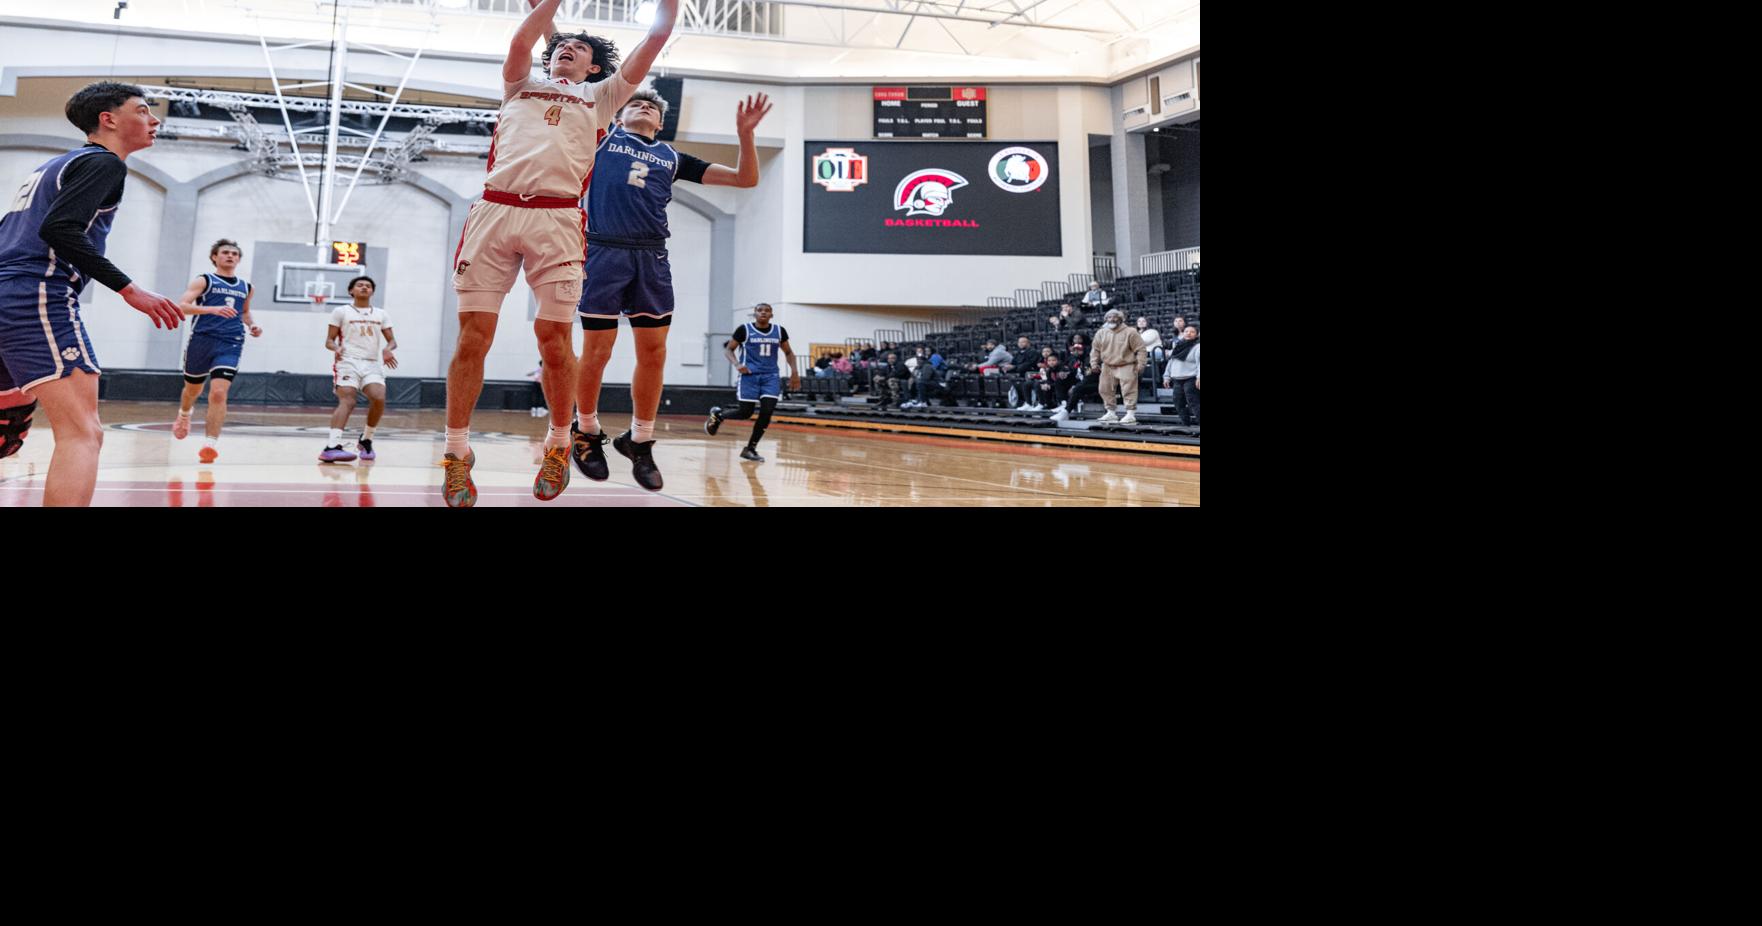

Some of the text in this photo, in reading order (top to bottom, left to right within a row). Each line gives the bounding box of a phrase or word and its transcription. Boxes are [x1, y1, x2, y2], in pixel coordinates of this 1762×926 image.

[544, 104, 563, 126] 4
[608, 142, 674, 171] DARLINGTON
[627, 161, 650, 189] 2
[884, 218, 980, 228] BASKETBALL
[759, 343, 771, 357] 11
